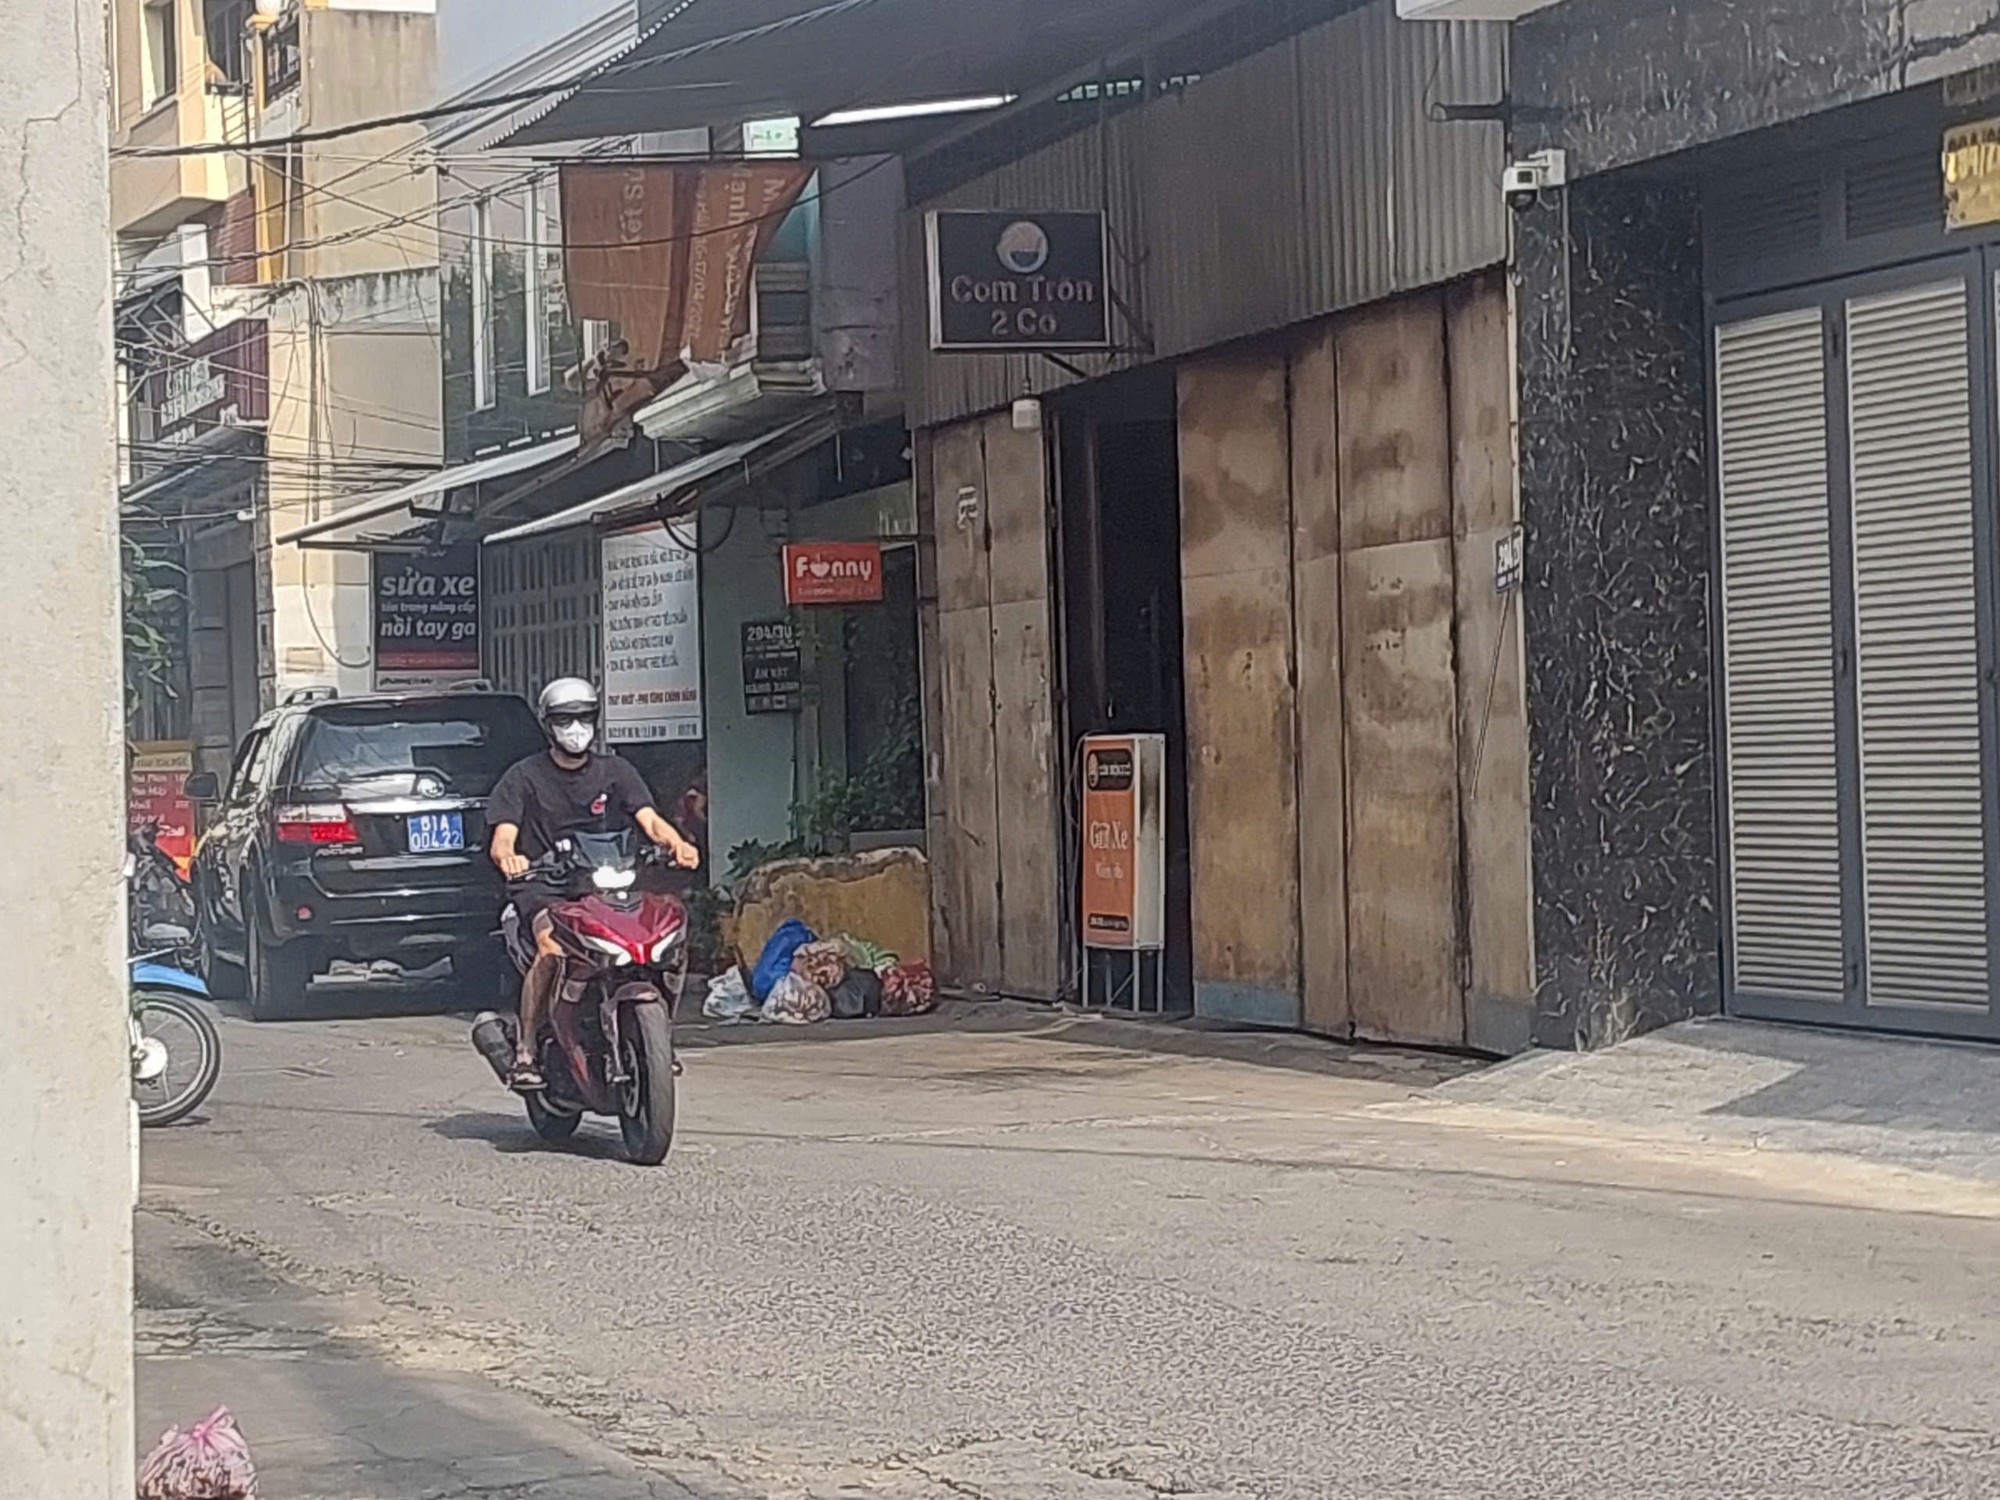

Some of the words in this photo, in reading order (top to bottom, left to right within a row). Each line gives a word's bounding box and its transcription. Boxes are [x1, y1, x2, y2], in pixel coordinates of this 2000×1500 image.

[991, 308, 1009, 336] 2
[381, 566, 436, 596] sửa
[441, 576, 476, 596] xe
[381, 614, 413, 637] nồi
[416, 619, 449, 641] tay
[451, 621, 477, 641] ga
